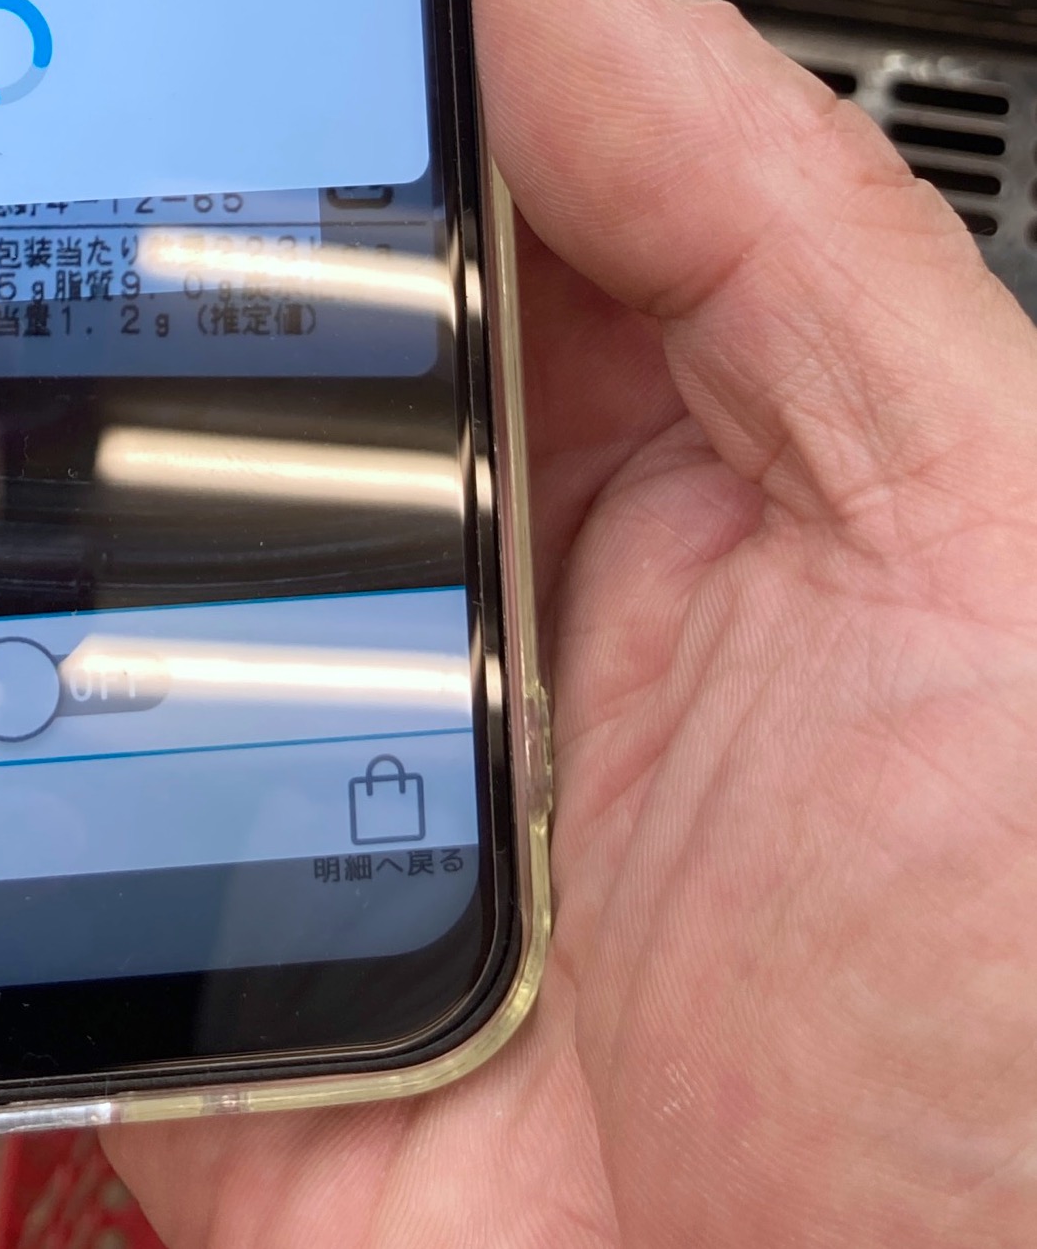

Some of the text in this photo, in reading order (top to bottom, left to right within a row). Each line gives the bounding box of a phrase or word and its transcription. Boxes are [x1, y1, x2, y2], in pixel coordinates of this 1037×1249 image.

[314, 847, 464, 883] 明細へ戻る
